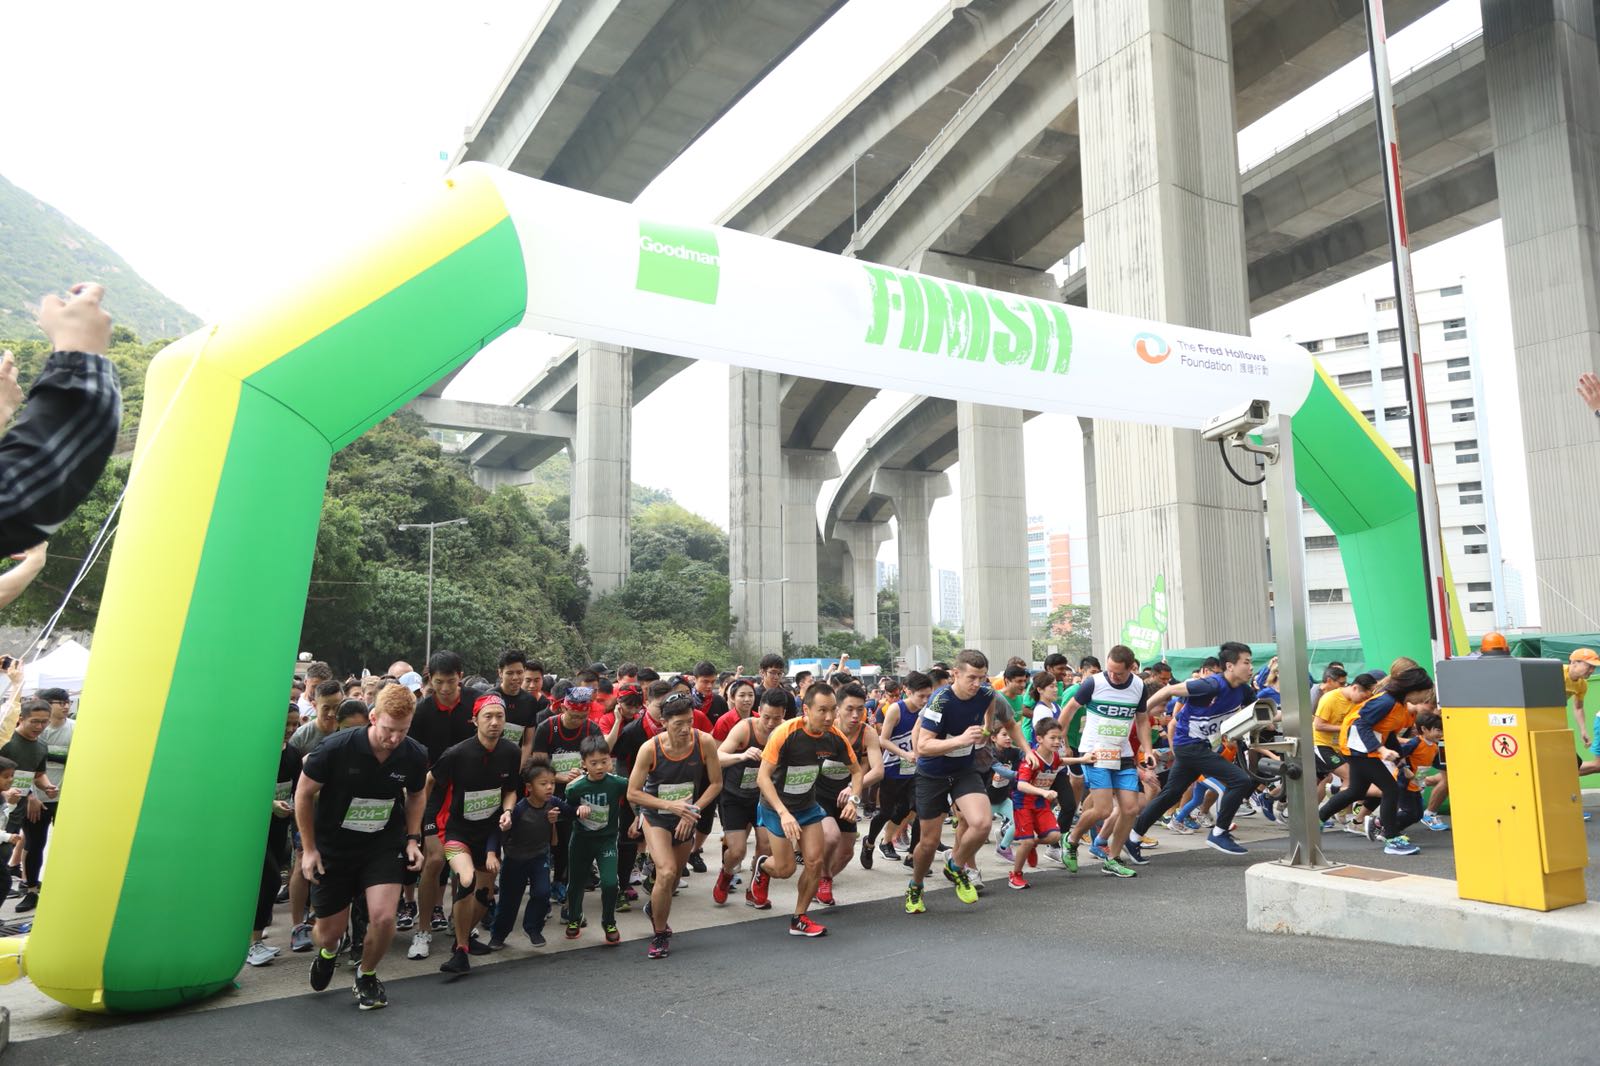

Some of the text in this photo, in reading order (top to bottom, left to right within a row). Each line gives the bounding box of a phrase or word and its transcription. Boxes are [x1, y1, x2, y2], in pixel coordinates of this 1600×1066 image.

[640, 235, 720, 267] Goodman
[863, 265, 1073, 375] FINISH
[1177, 340, 1267, 362] The Fred Hollows
[1180, 355, 1233, 373] Foundation
[1096, 704, 1137, 717] CBRE
[1100, 726, 1126, 736] 261-2
[466, 797, 500, 812] 208-2
[349, 808, 389, 820] 204-1
